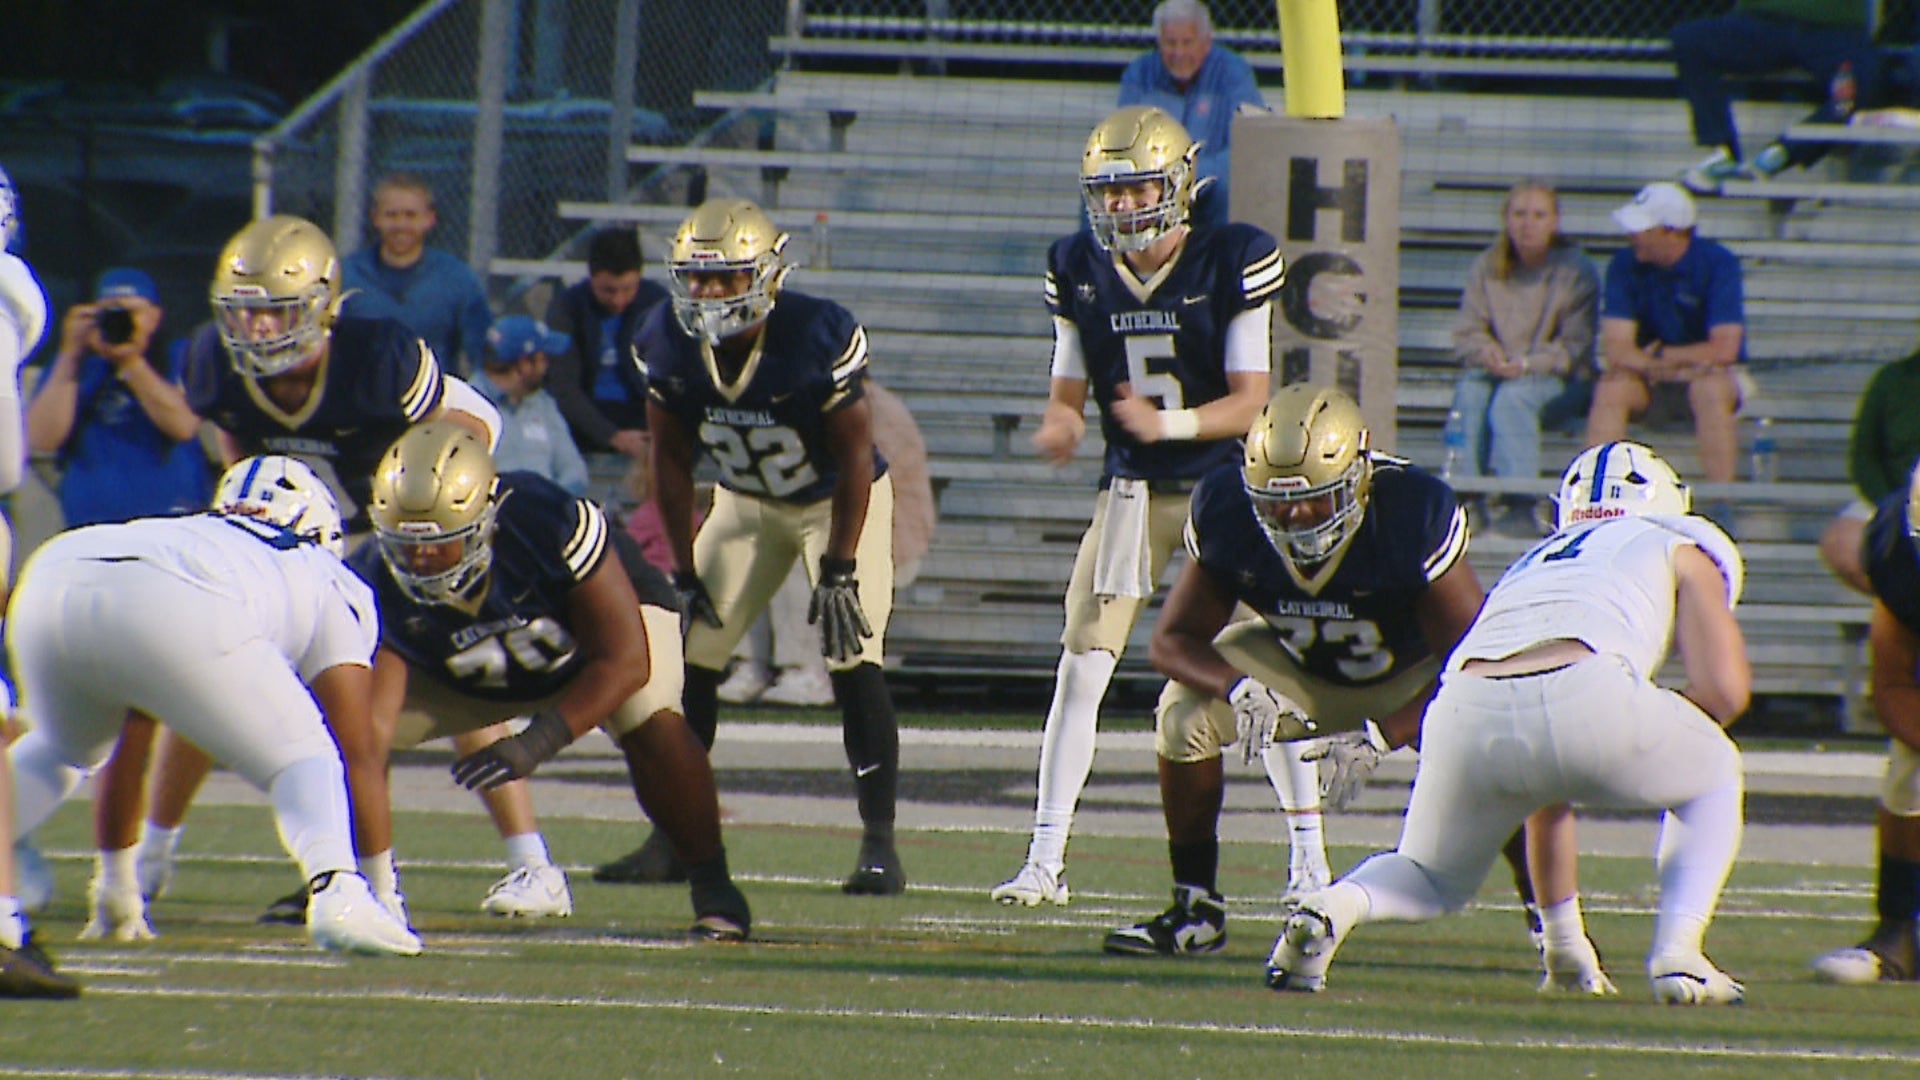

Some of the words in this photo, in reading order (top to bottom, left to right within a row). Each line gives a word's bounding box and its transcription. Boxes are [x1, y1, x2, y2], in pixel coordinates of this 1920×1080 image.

[1110, 311, 1181, 332] CATHEDRAL
[1124, 334, 1184, 411] 5
[705, 407, 776, 426] CATHEDRAL
[699, 421, 819, 497] 22
[1278, 599, 1355, 620] CATHEDRAL
[446, 616, 578, 688] 70
[1264, 613, 1395, 681] 73
